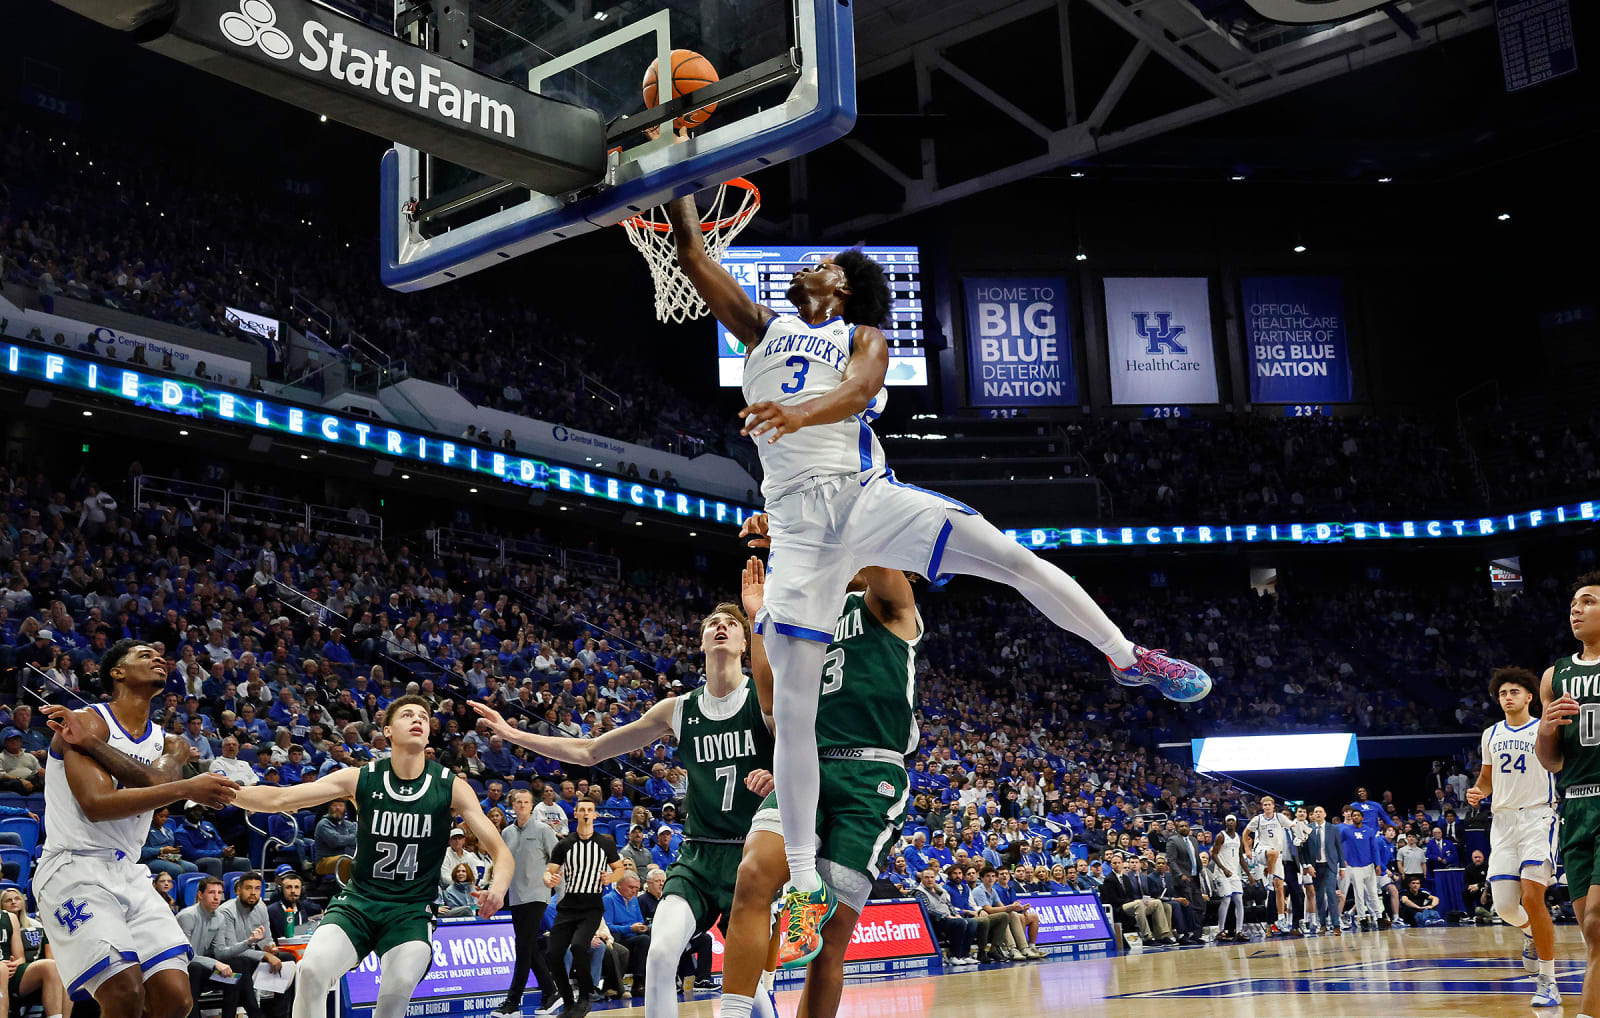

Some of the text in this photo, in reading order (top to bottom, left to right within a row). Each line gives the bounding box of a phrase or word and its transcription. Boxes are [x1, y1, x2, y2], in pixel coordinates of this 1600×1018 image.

[976, 287, 1055, 301] HOME TO
[977, 302, 1057, 338] BIG
[1250, 303, 1310, 317] OFFICIAL
[1131, 310, 1188, 355] UK
[1251, 316, 1339, 330] HEALTHCARE
[1253, 329, 1334, 344] PARTNER OF
[764, 334, 846, 370] KENTUCKY
[980, 338, 1059, 362] BLUE
[1255, 344, 1336, 361] BIG BLUE
[781, 355, 810, 394] 3
[982, 364, 1061, 381] DETERMI
[1125, 357, 1200, 372] HealthCare
[1256, 361, 1328, 377] NATION
[1153, 407, 1181, 418] 236
[218, 393, 536, 482] ELECTRIFIED
[559, 467, 762, 526] ELECTRIFI
[1070, 523, 1331, 545] ELECTRIFIED
[822, 647, 846, 695] 3
[693, 729, 757, 763] LOYOLA
[1492, 739, 1536, 755] KENTUCKY
[1500, 753, 1527, 774] 24
[715, 764, 737, 811] 7
[371, 809, 432, 838] LOYOLA
[1267, 829, 1274, 838] 5
[373, 841, 419, 881] 24
[55, 897, 95, 935] UK
[1063, 903, 1100, 923] MORGAN
[433, 940, 448, 967] &
[449, 968, 475, 978] INJURY
[476, 967, 492, 976] LAW
[492, 965, 511, 975] FIRM
[406, 1003, 425, 1016] FARM
[425, 1001, 450, 1015] BUREAU
[464, 999, 474, 1010] BIG
[475, 999, 485, 1010] ON
